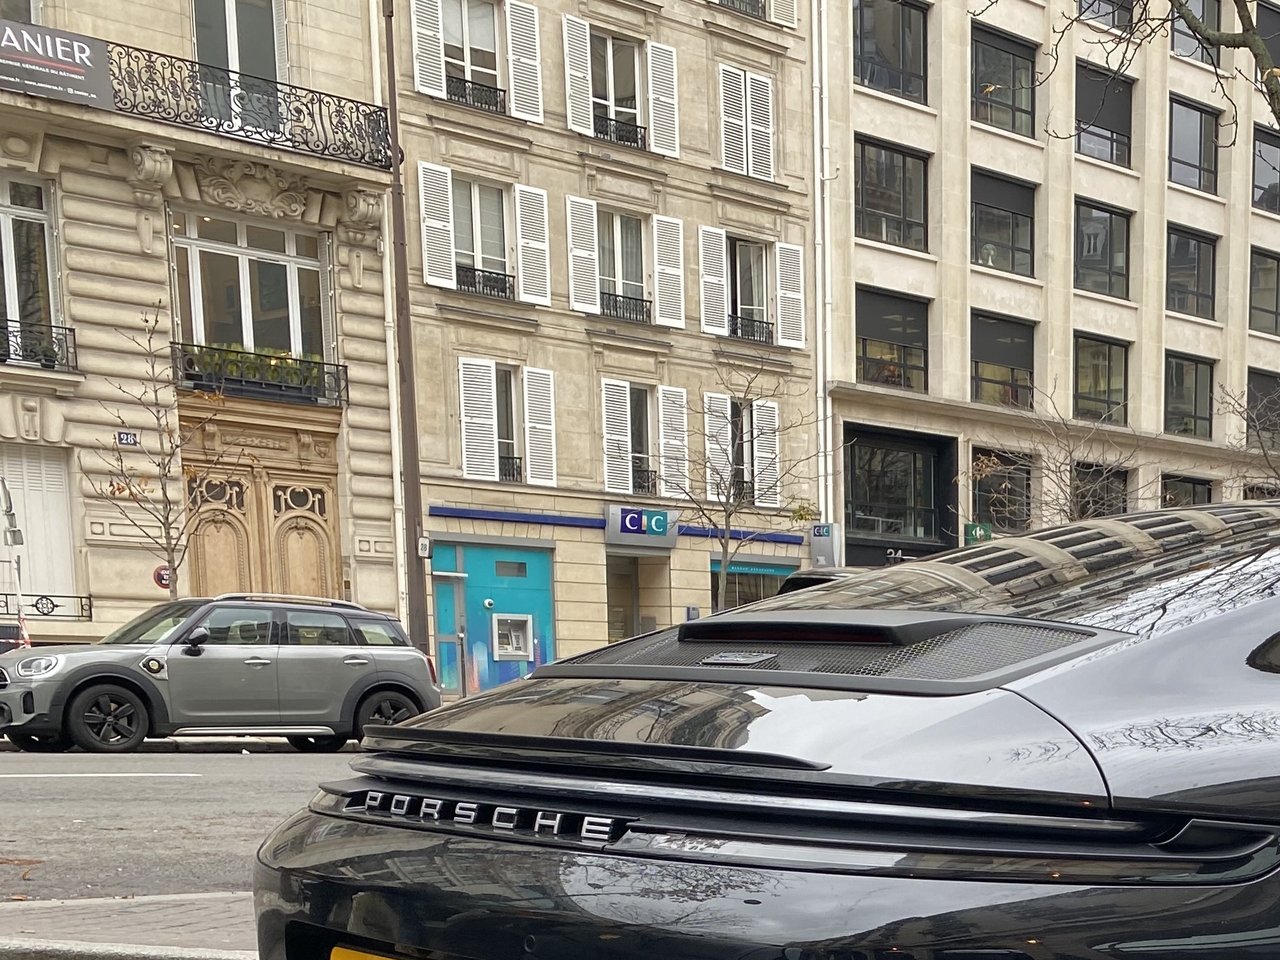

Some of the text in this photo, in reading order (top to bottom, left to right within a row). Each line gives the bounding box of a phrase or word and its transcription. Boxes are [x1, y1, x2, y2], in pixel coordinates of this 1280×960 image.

[1, 26, 94, 67] ANIER
[120, 433, 134, 444] 28
[625, 513, 664, 532] CIC
[814, 526, 829, 536] CIC
[364, 791, 615, 840] PORSCHE
